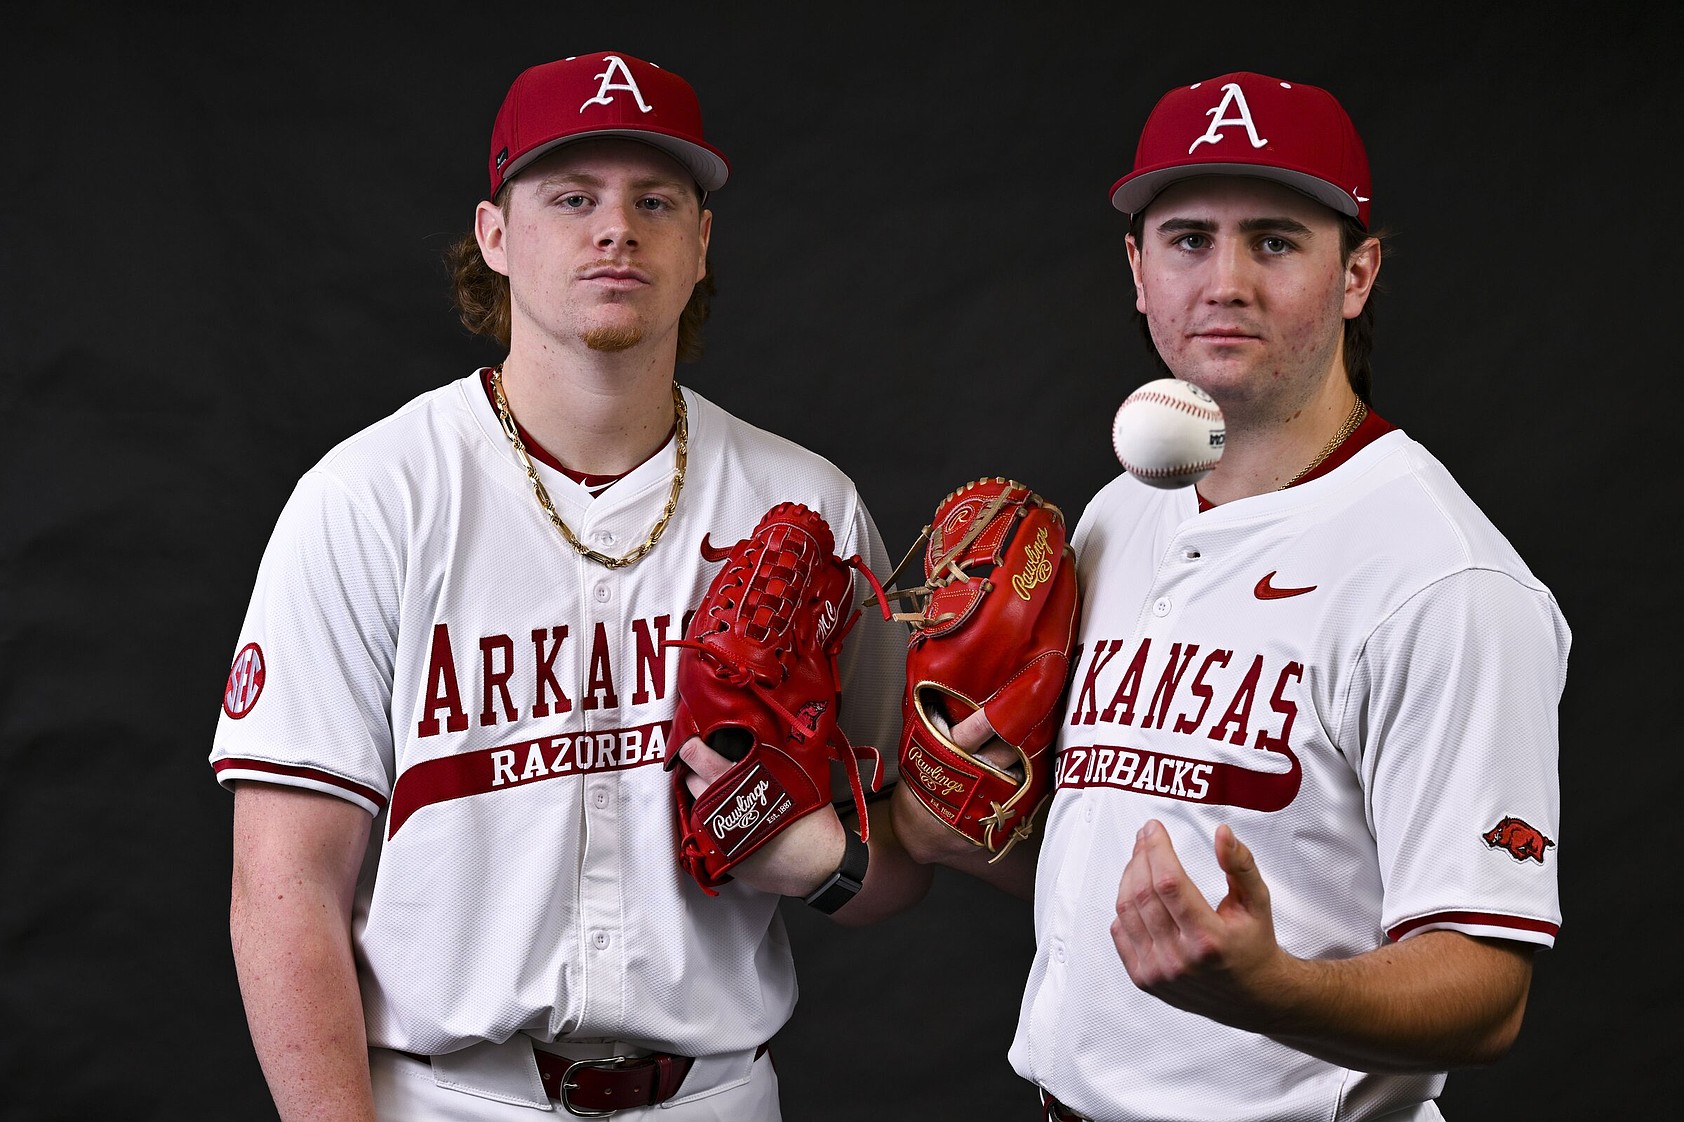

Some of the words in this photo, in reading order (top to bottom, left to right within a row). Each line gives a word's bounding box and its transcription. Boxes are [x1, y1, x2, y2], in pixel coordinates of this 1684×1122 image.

[579, 55, 652, 114] A
[1188, 83, 1268, 154] A
[1012, 526, 1054, 601] Rawlings
[225, 647, 262, 714] SEC
[417, 609, 697, 738] ARKAN
[1067, 637, 1304, 750] KANSAS
[490, 725, 667, 787] RAZORBA
[908, 746, 965, 796] Rawlings
[712, 780, 769, 839] Rawlings
[766, 813, 780, 825] Est.
[777, 799, 792, 815] 1887
